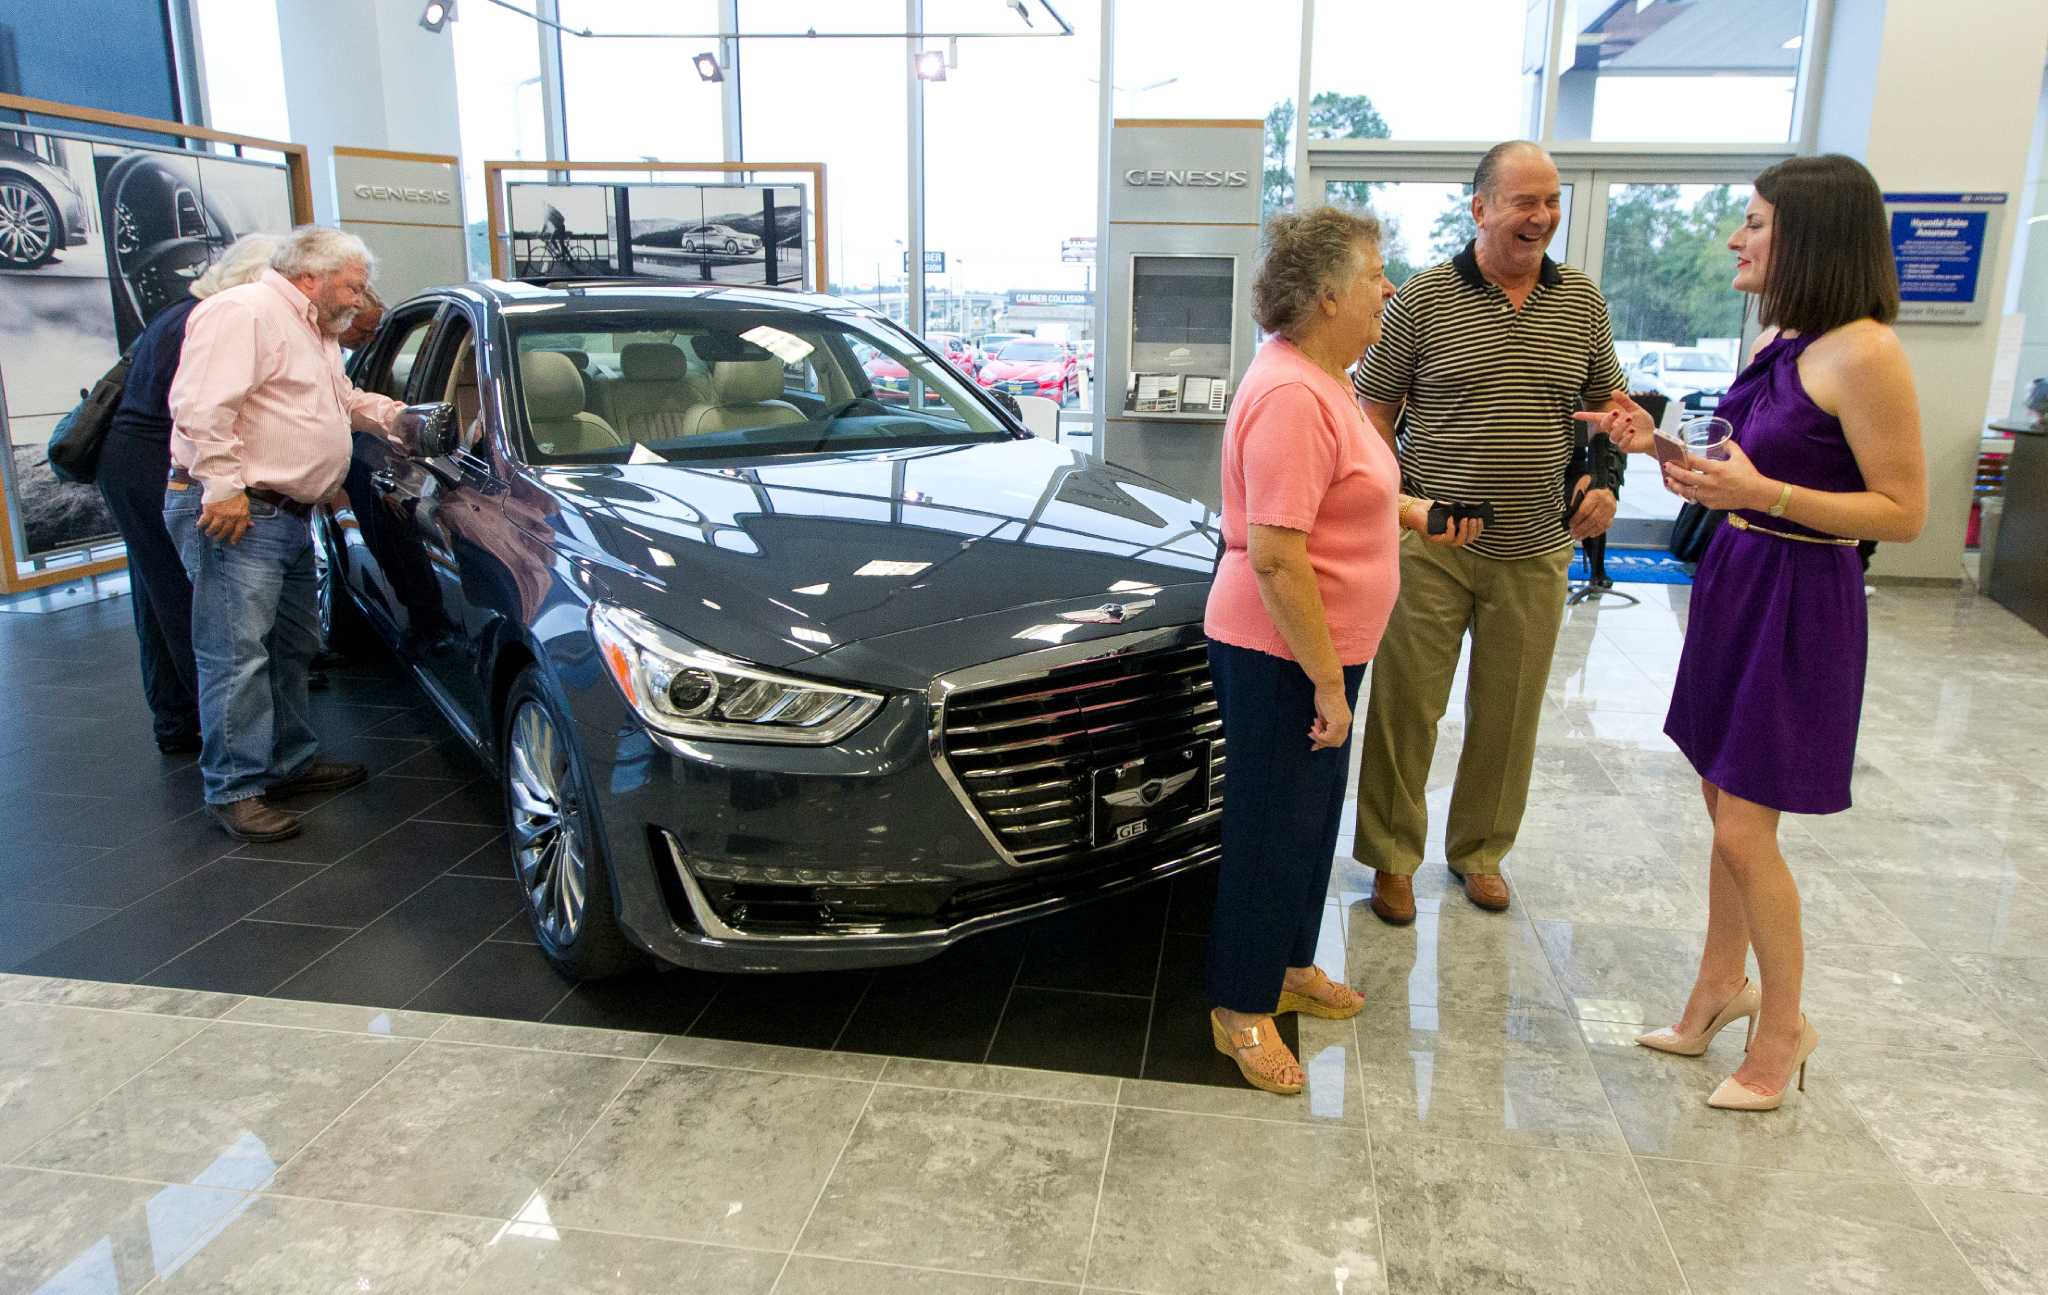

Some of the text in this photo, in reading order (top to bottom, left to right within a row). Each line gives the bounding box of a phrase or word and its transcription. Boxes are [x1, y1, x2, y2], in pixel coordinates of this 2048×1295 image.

[1124, 168, 1249, 188] GENESIS
[353, 184, 451, 205] GENESIS
[1016, 294, 1086, 304] CALIBER COLLISION
